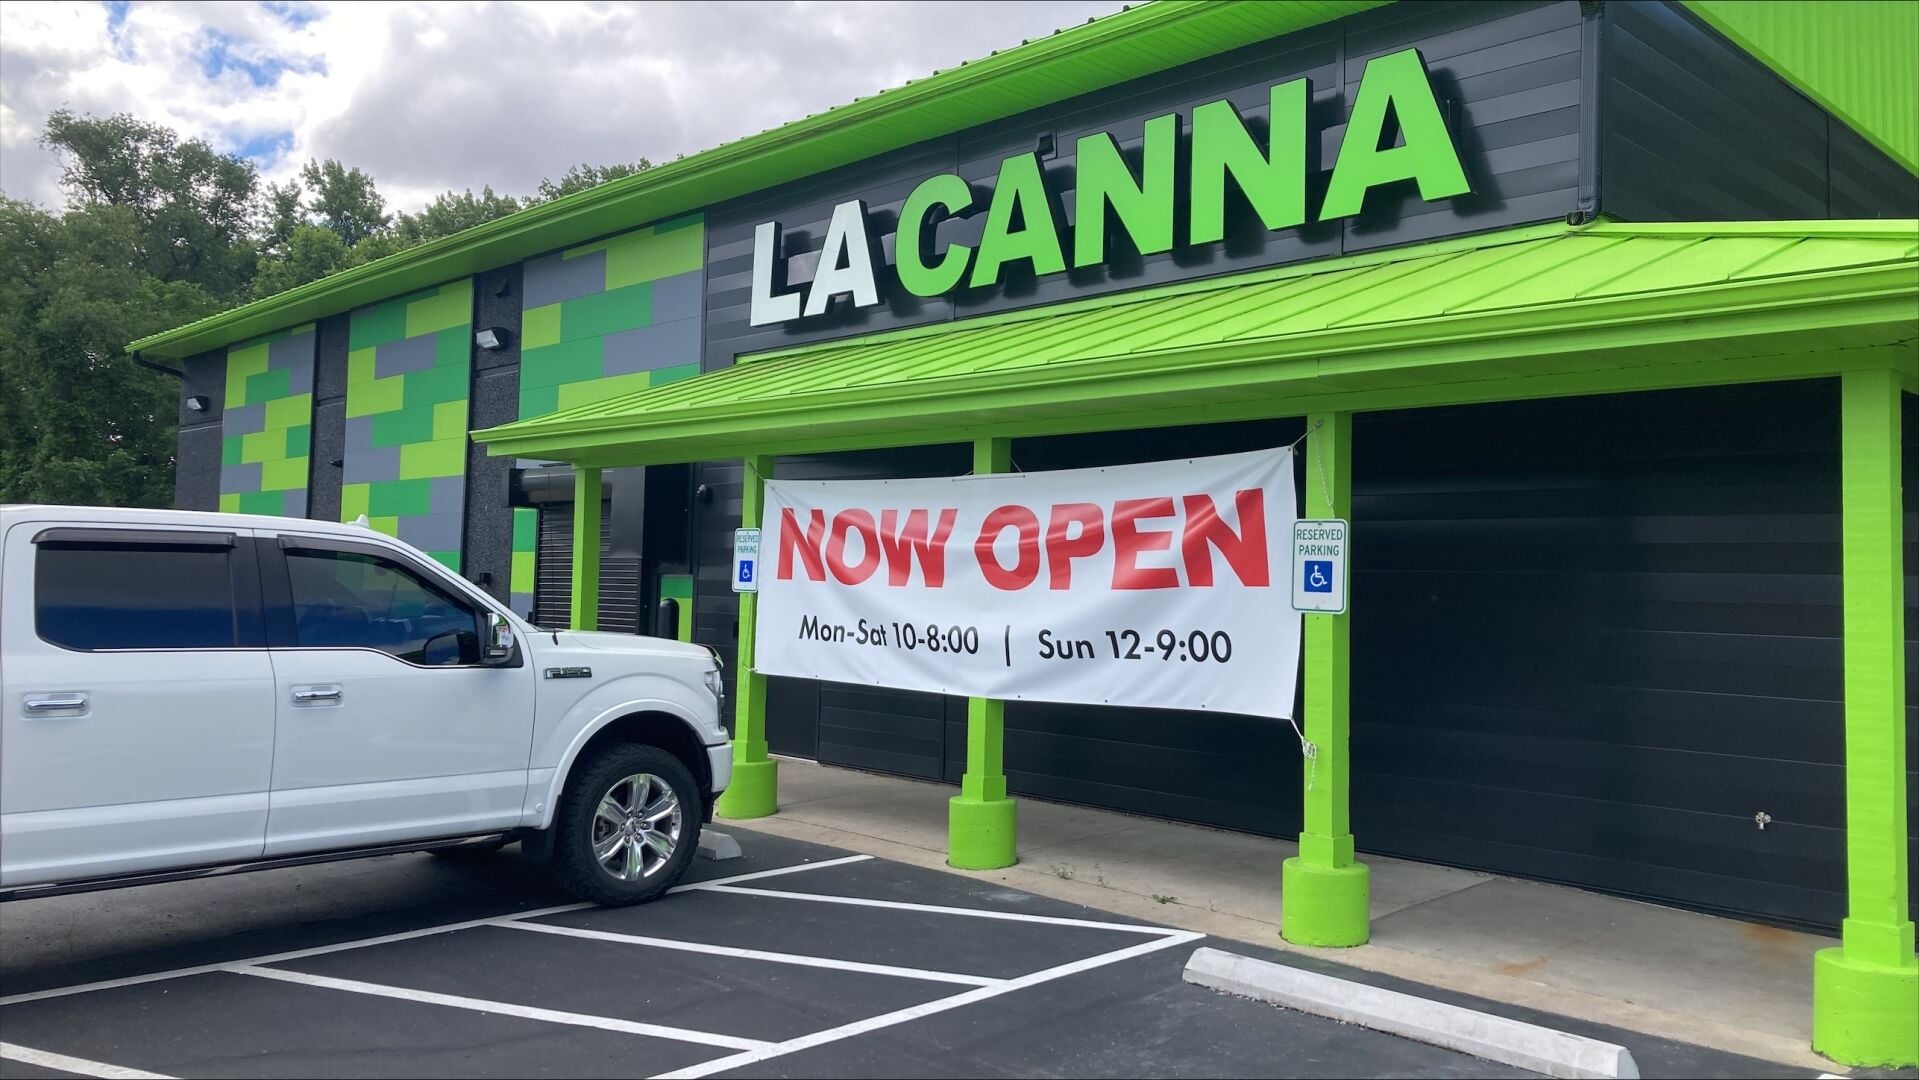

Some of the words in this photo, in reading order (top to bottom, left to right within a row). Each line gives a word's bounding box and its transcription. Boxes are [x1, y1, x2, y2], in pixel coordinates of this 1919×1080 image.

[750, 199, 880, 327] LA
[895, 47, 1472, 297] CANNA
[777, 508, 958, 588] NOW
[974, 488, 1271, 591] OPEN
[1296, 528, 1343, 541] RESERVED
[1299, 544, 1340, 556] PARKING
[799, 614, 888, 647] Mon-Sat
[892, 622, 979, 654] 10-8:00
[1038, 629, 1095, 660] Sun
[1105, 629, 1232, 663] 12-9:00
